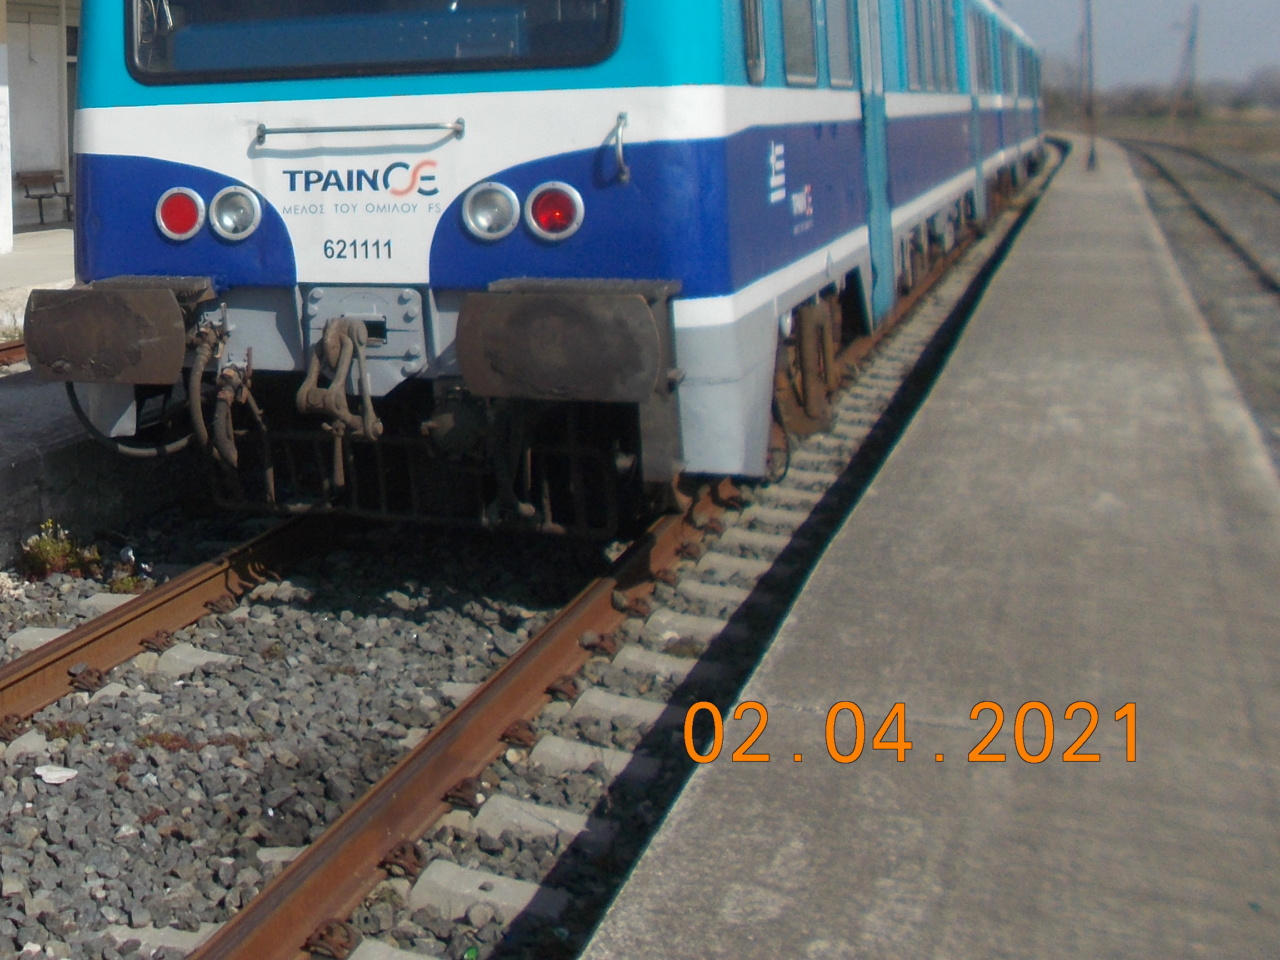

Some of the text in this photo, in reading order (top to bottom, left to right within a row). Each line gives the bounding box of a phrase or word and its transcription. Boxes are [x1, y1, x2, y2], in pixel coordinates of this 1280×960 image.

[282, 204, 325, 215] ΜΕΛΟΣ
[334, 203, 357, 214] ΤΟΥ
[428, 202, 442, 214] FS
[323, 239, 392, 259] 621111
